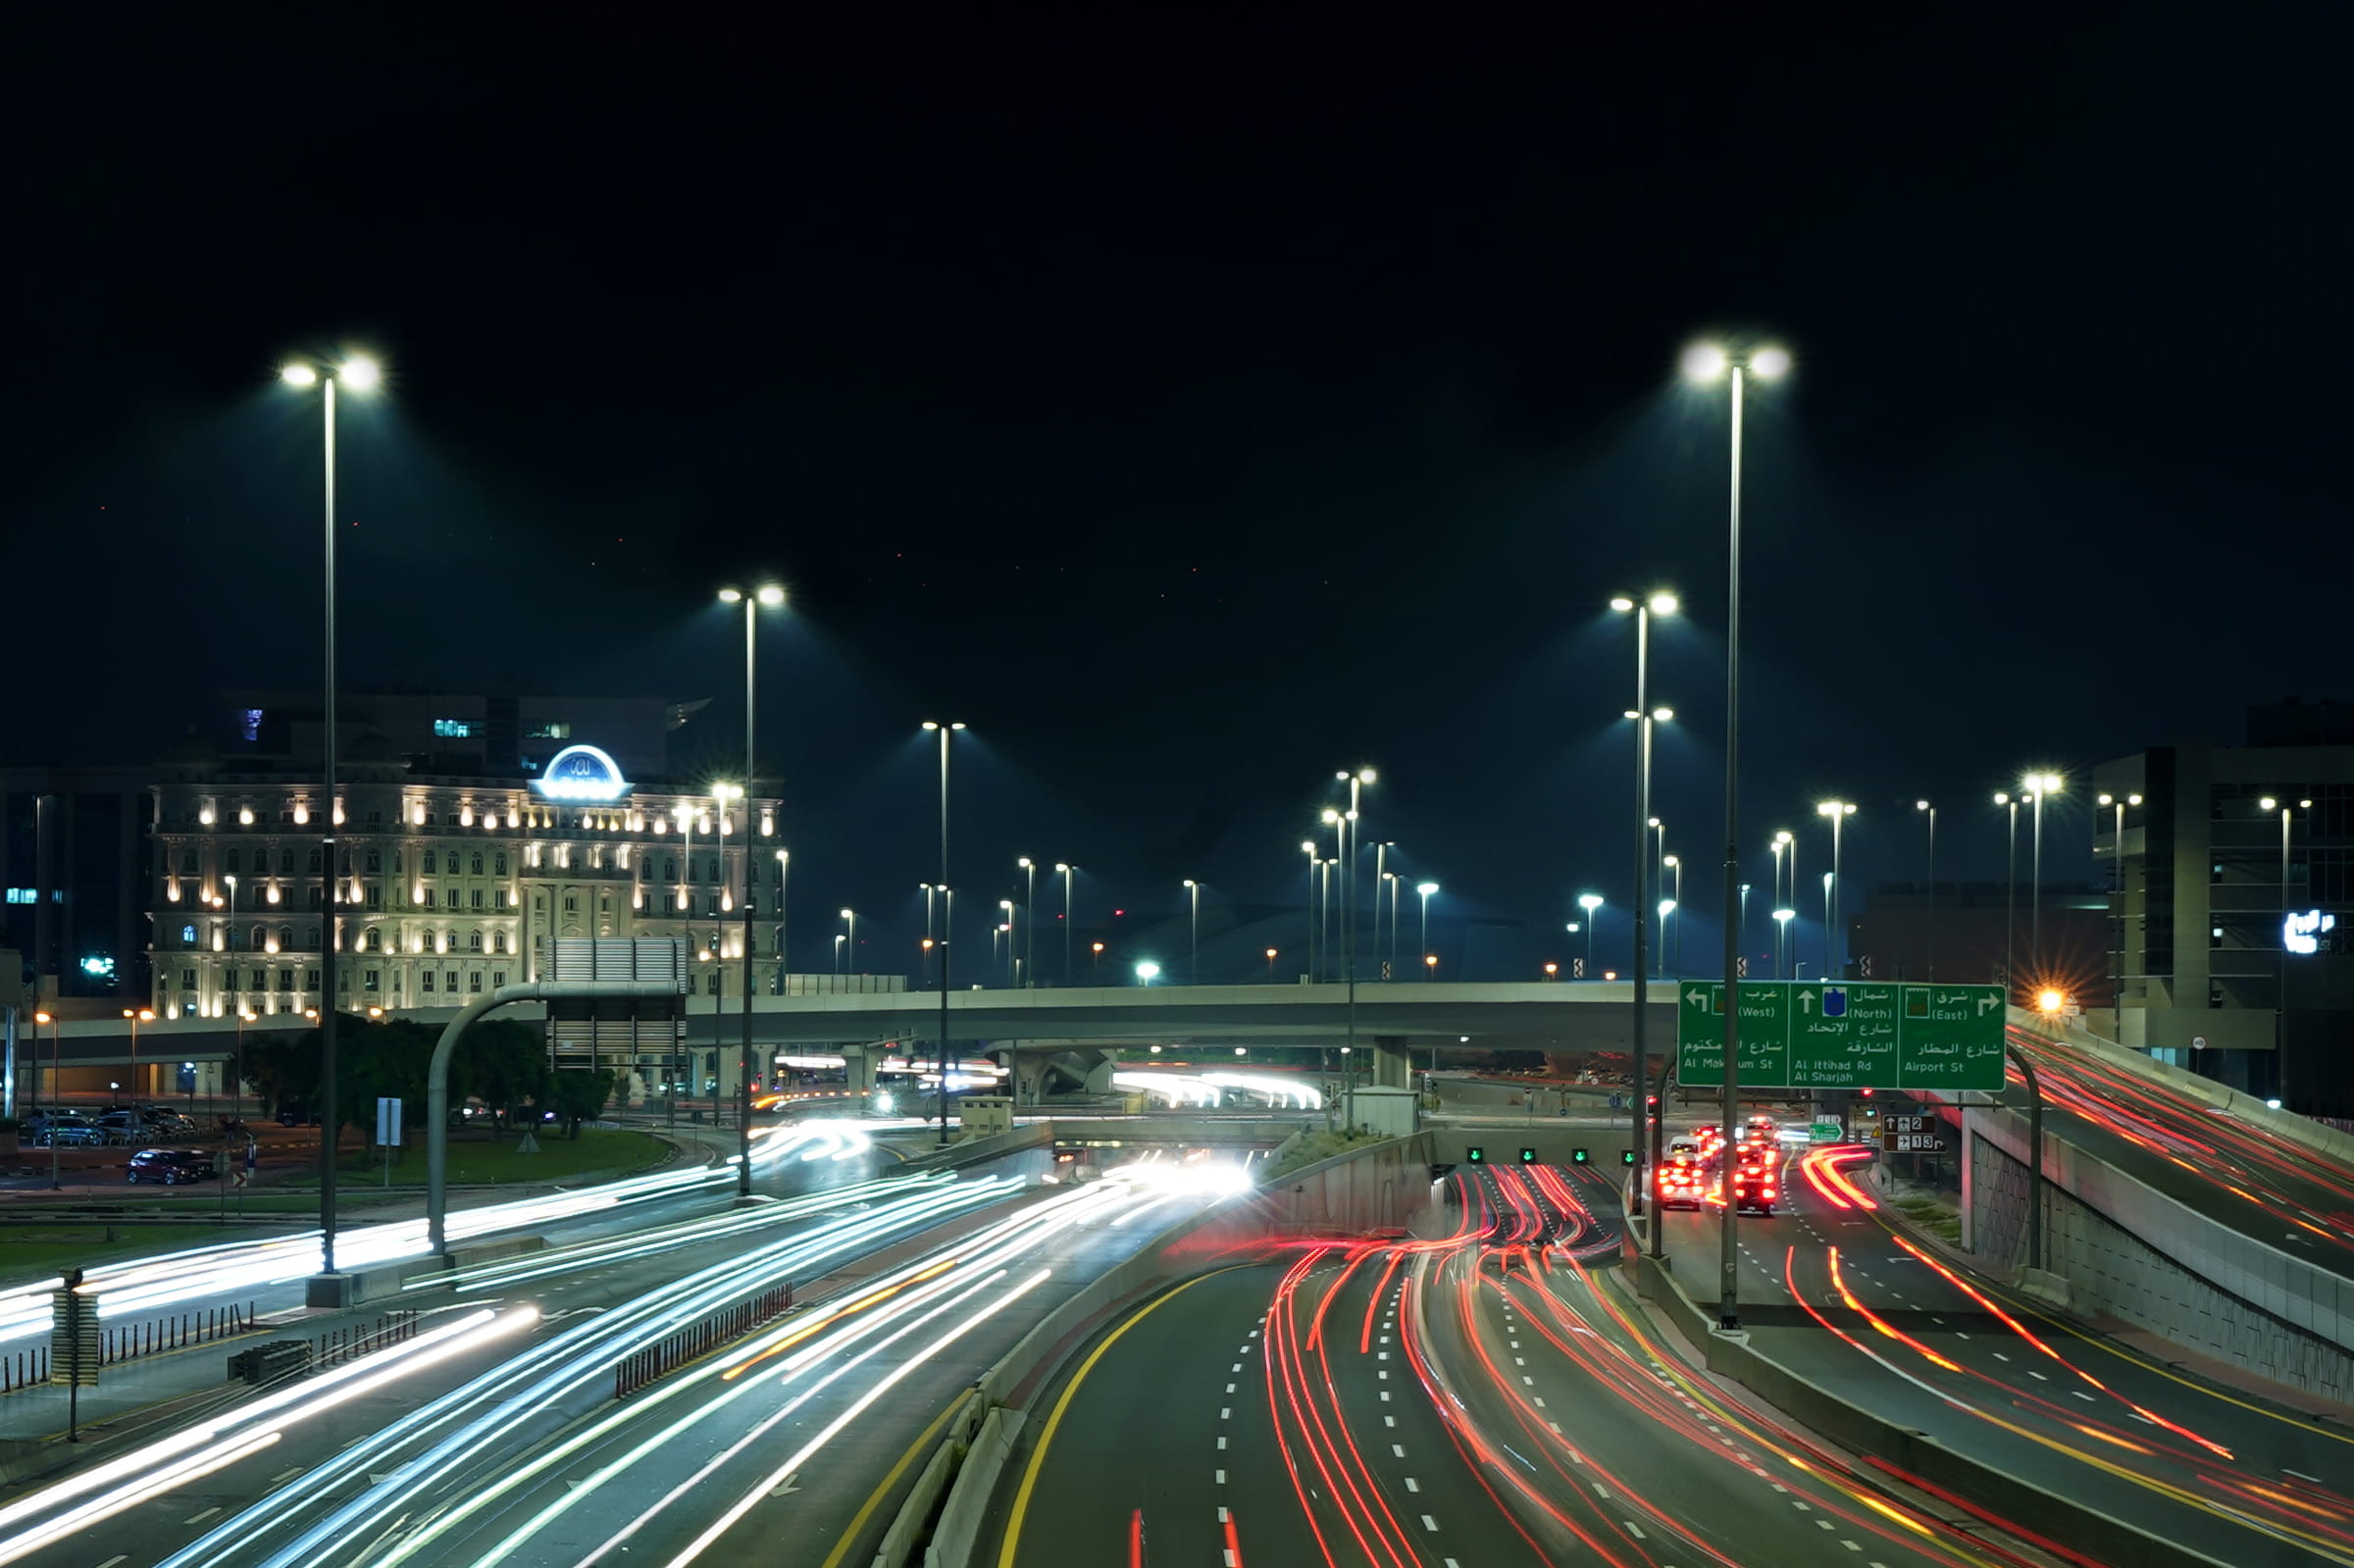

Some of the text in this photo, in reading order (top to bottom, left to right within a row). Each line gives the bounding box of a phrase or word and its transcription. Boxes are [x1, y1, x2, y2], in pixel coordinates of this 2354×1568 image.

[1738, 1007, 1774, 1017] (West)
[1849, 1008, 1892, 1019] (North)
[1931, 1009, 1968, 1020] (East)
[1859, 1023, 1893, 1036] شارع
[1684, 1038, 1722, 1055] مكتوم
[1749, 1040, 1783, 1054] شارع
[1846, 1040, 1893, 1055] الشارقة
[1918, 1043, 2000, 1058] شارع المطار
[1684, 1058, 1773, 1069] Al Makum St
[1795, 1060, 1871, 1071] Al Ittihad Rd
[1905, 1062, 1965, 1074] Airport St
[1795, 1072, 1853, 1083] Al Sharjah
[1913, 1118, 1921, 1128] 2
[1923, 1137, 1932, 1146] 3
